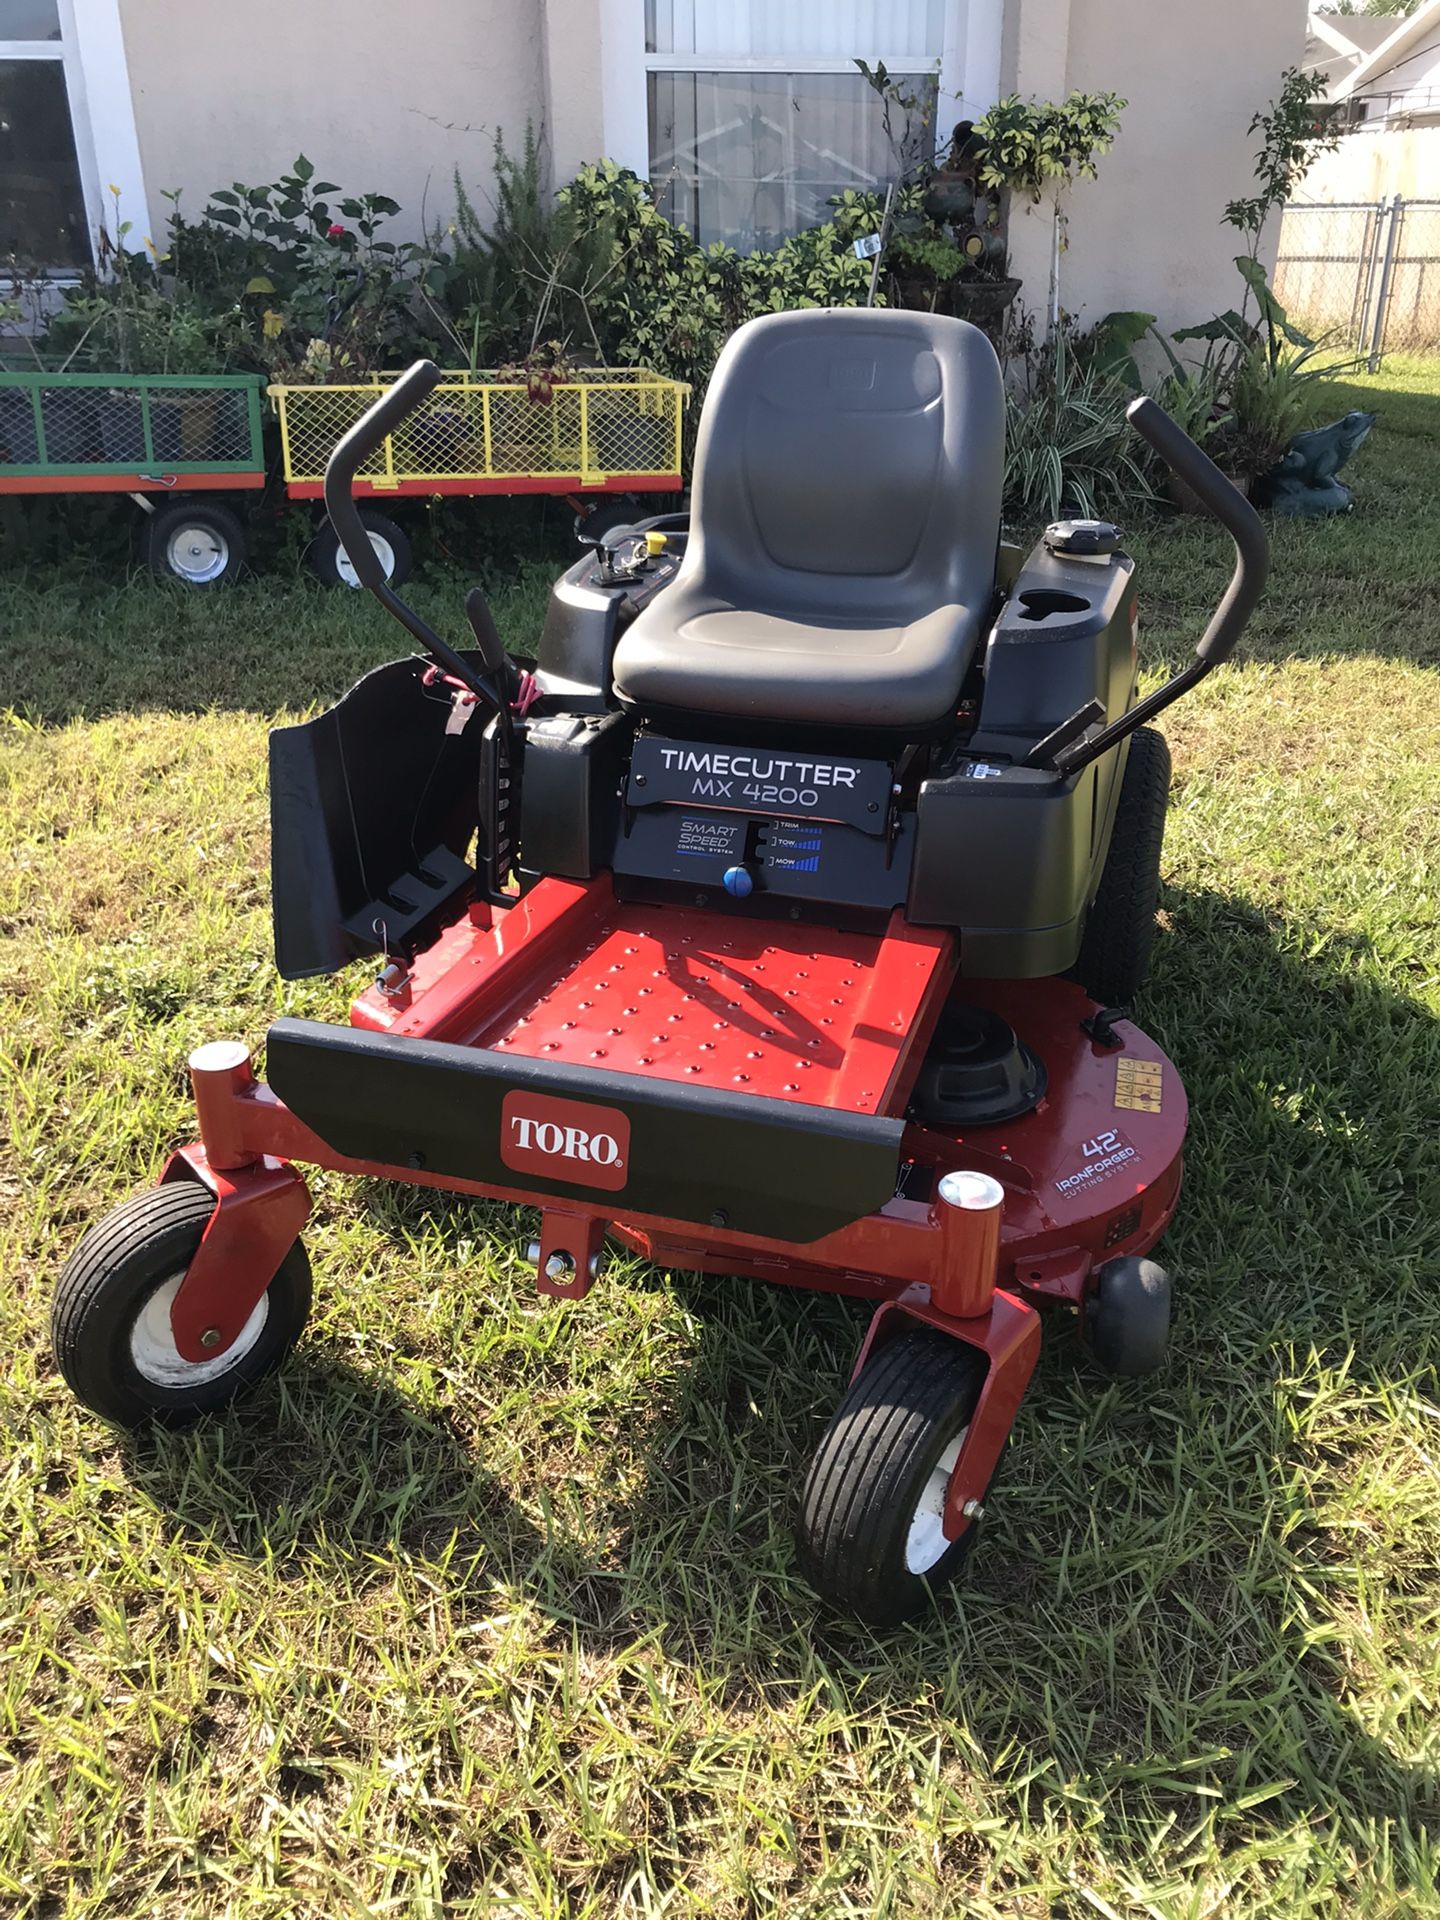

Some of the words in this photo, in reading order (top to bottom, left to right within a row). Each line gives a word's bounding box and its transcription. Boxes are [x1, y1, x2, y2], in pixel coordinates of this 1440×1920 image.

[692, 778, 733, 798] MX
[742, 783, 819, 807] 4200
[680, 821, 738, 837] SMART
[780, 821, 799, 829] TRIM
[678, 833, 731, 848] SPEED
[778, 838, 795, 846] TOW
[677, 844, 705, 852] CONTROL
[775, 857, 796, 866] MOW
